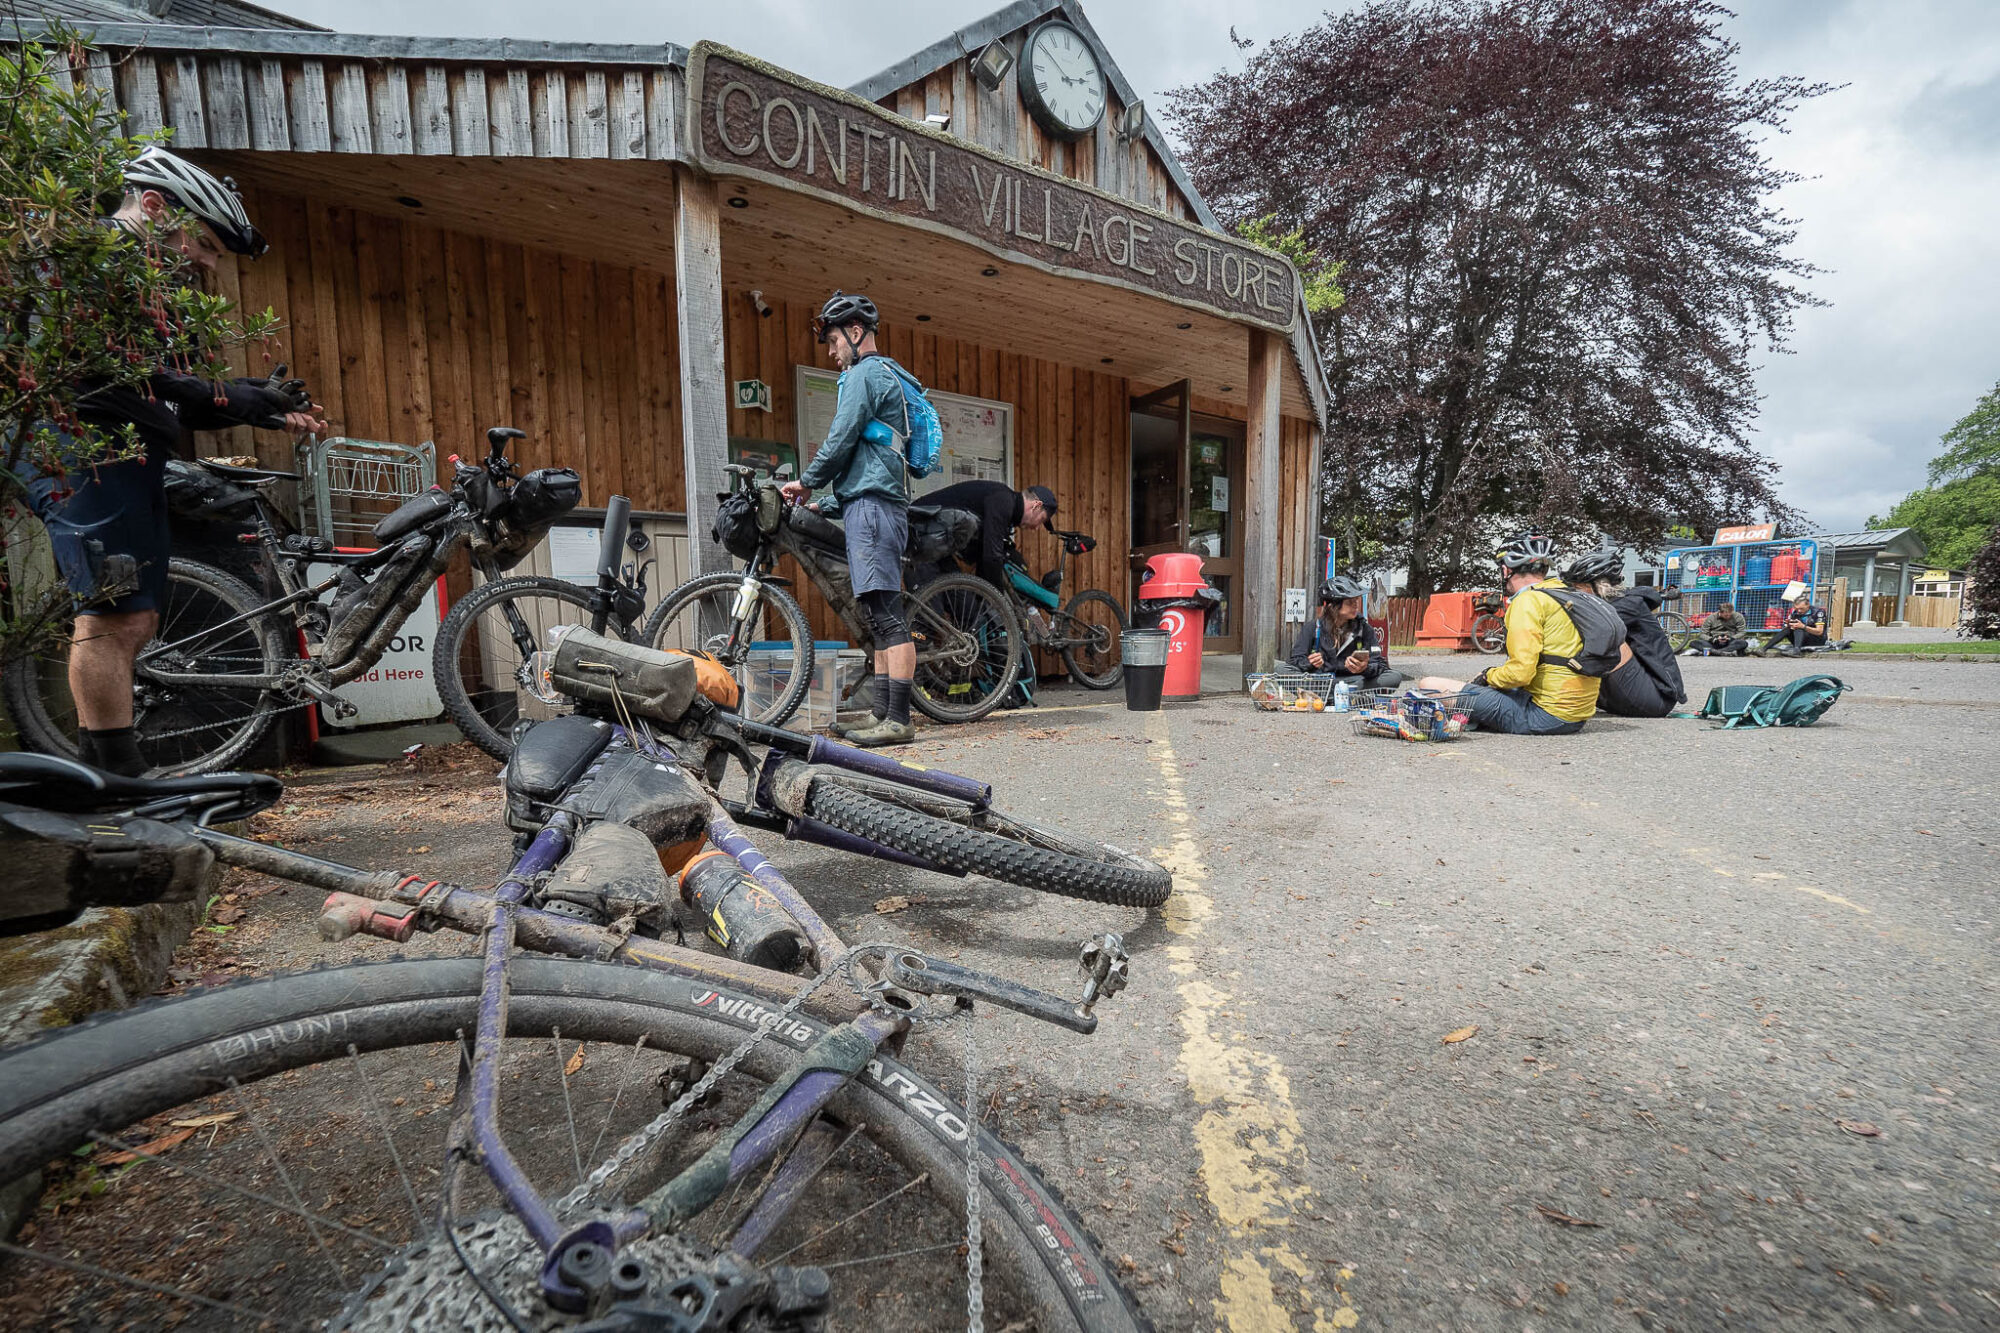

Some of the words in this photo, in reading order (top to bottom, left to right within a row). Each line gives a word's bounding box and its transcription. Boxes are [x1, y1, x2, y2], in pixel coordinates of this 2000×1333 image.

[716, 81, 936, 212] CONTIN
[971, 165, 1156, 276] VILLAGE
[1174, 238, 1286, 313] STORE
[1720, 529, 1768, 541] CALOR
[490, 581, 538, 594] RACING
[352, 669, 379, 683] old
[385, 669, 424, 681] Here
[248, 1010, 352, 1052] HUNT
[866, 1058, 969, 1141] ARZO
